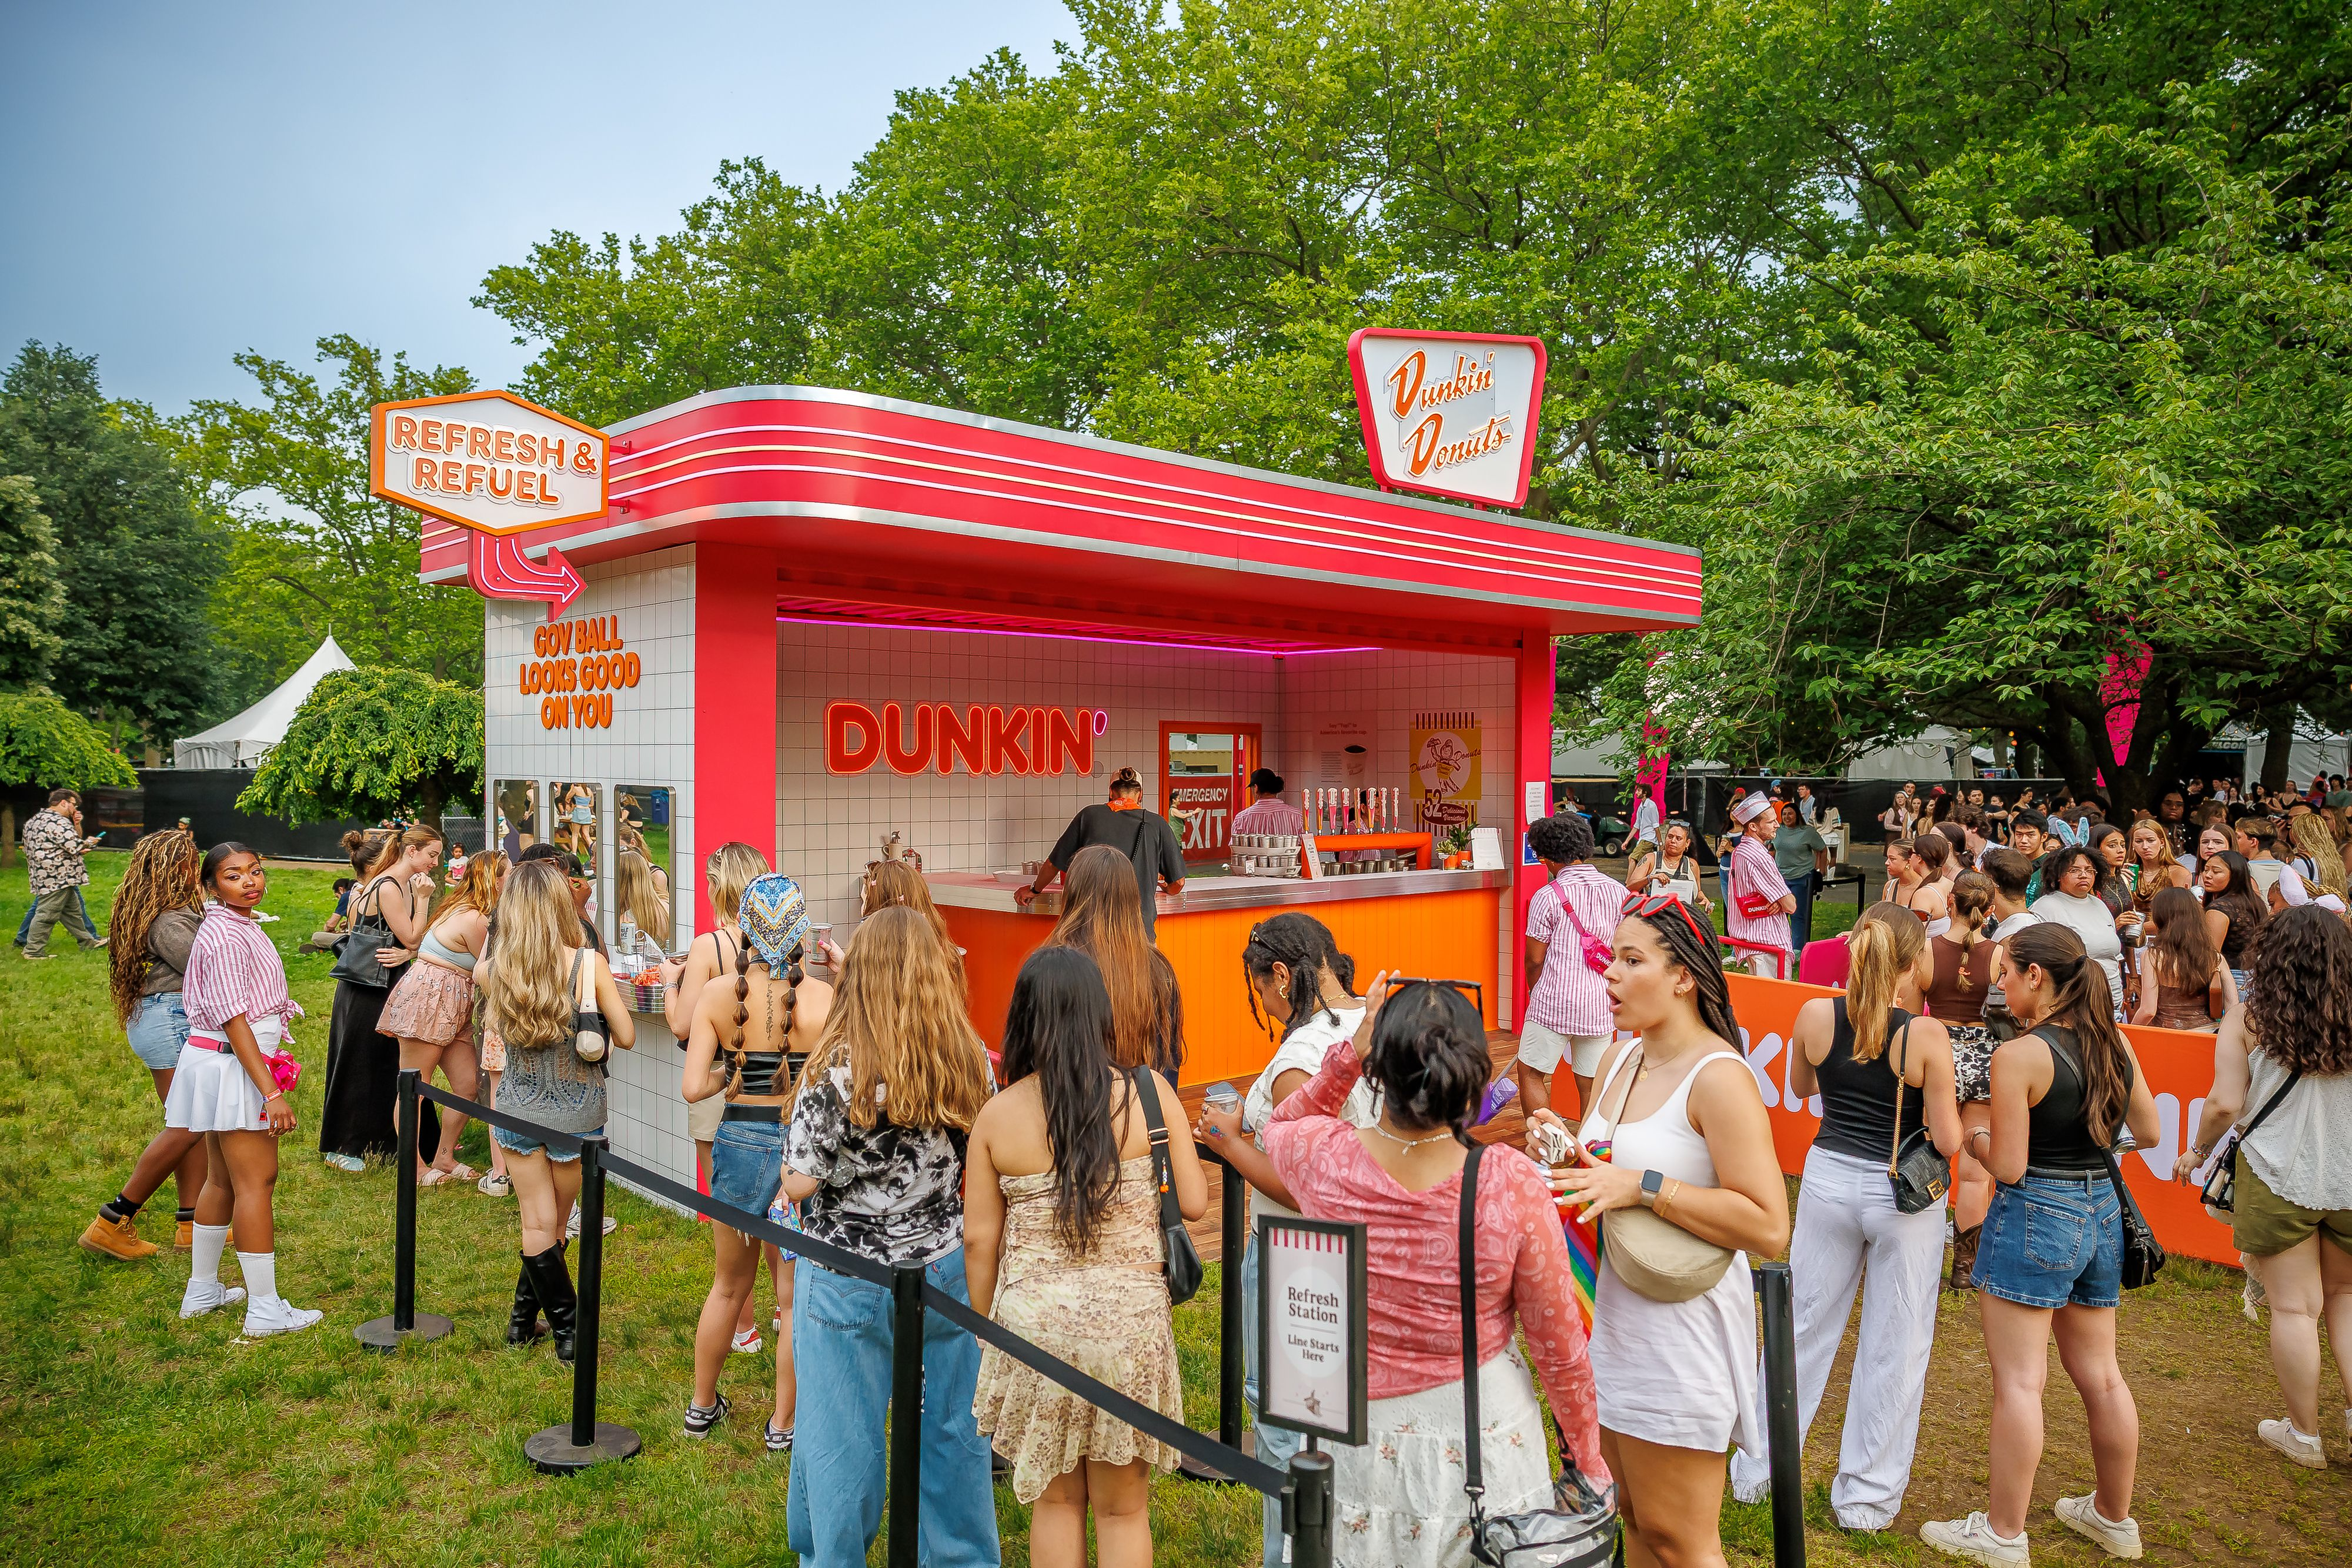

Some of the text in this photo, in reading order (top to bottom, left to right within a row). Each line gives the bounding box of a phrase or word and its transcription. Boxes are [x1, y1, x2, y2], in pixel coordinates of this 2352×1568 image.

[1387, 349, 1496, 419] Dunkin'
[392, 414, 599, 474] REFRESH &
[1402, 411, 1512, 478] Donuts
[412, 457, 561, 506] REFUEL
[533, 614, 623, 658] GOV BALL
[519, 652, 640, 695] LOOKS GOOD
[540, 693, 613, 730] ON YOU
[826, 701, 1108, 776] DUNKIN'
[1454, 748, 1481, 762] Donuts
[1424, 788, 1442, 817] 52
[1442, 806, 1465, 814] Delicious
[1181, 808, 1227, 849] XIT
[1595, 952, 1613, 967] DUNKI
[1287, 1286, 1339, 1308] Refresh
[1288, 1303, 1339, 1324] Station
[1287, 1333, 1339, 1353] Line Starts
[1302, 1349, 1325, 1363] Here
